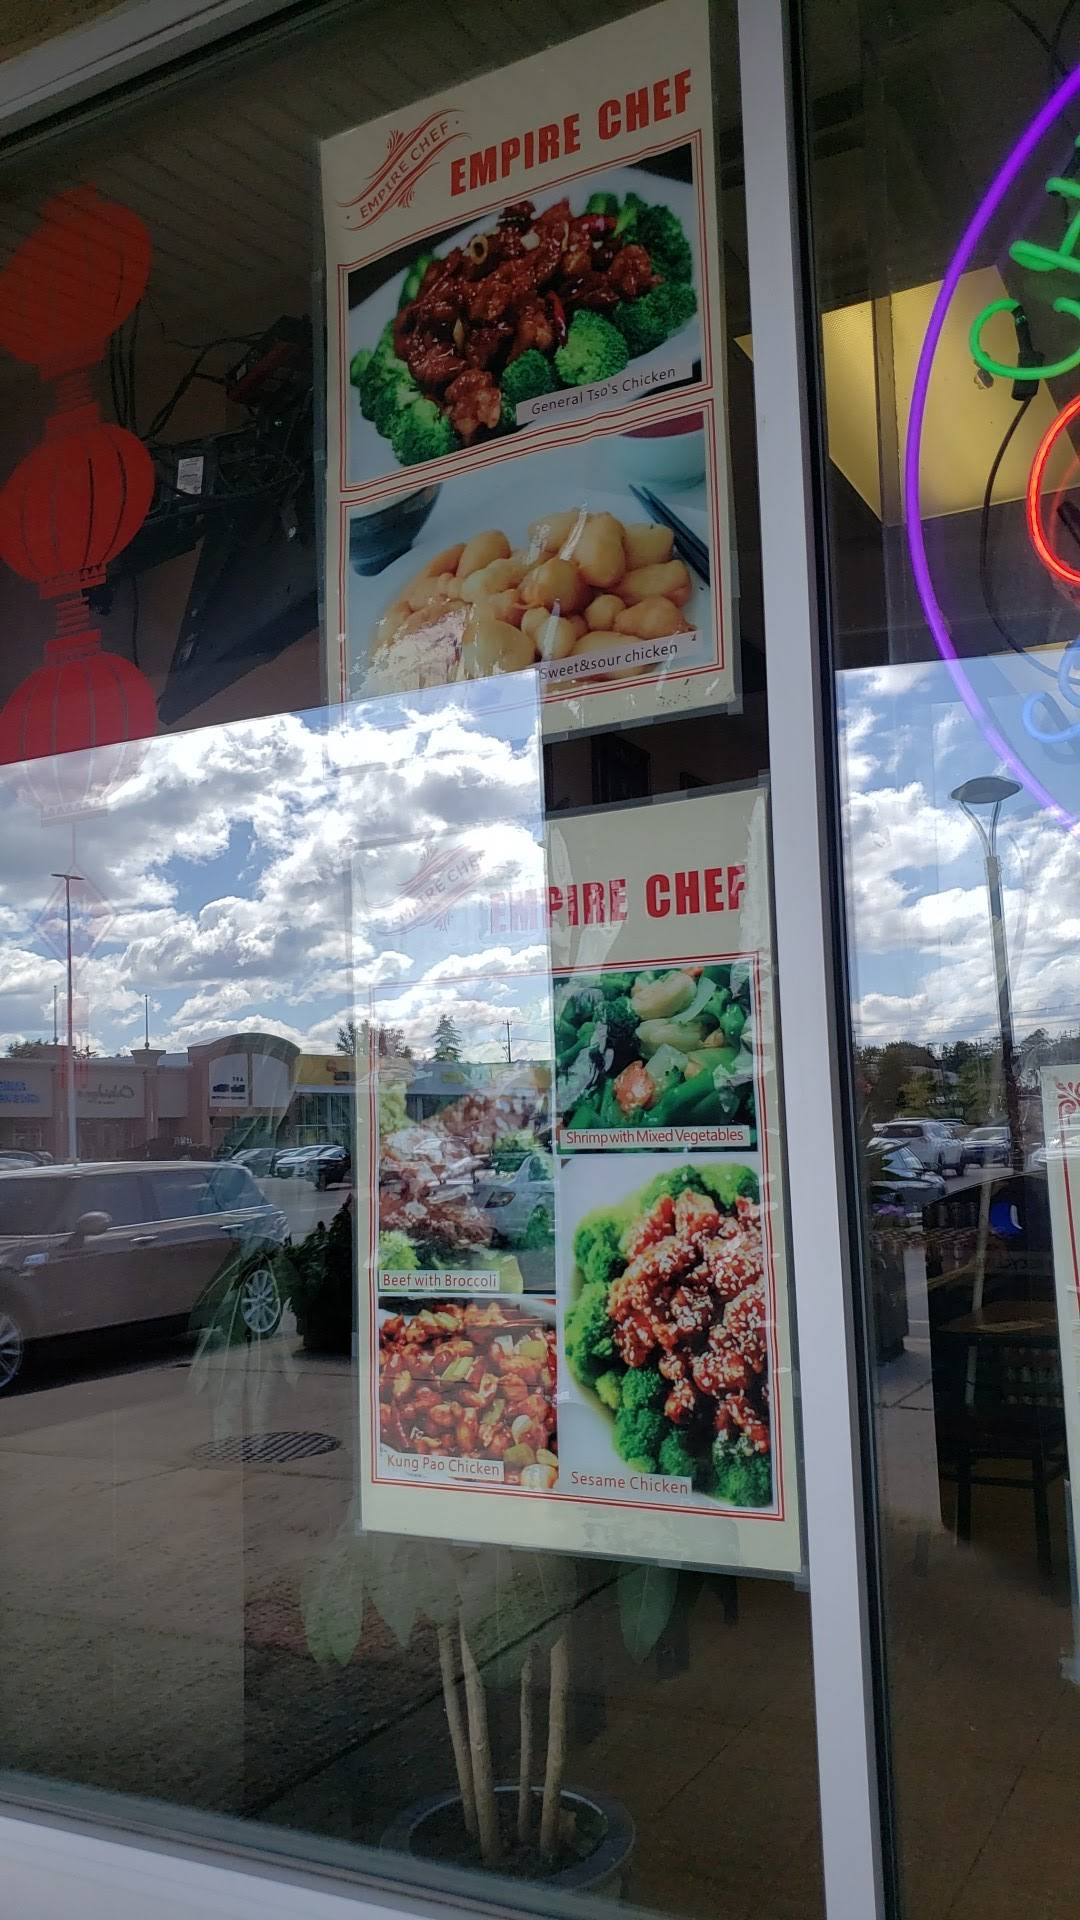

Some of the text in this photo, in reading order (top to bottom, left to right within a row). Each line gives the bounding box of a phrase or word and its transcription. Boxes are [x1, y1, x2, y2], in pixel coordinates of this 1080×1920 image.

[451, 69, 692, 196] EMPIRE CHEF
[360, 121, 449, 218] EMPIRE CHEF
[532, 367, 676, 415] General Tso's Chicken
[540, 643, 678, 680] Sweet&sour chicken
[490, 864, 746, 934] EMPIRE CHEF
[566, 1127, 744, 1146] Shrimp with Mixed Vegetables
[383, 1273, 497, 1287] Beef with Broccoli
[387, 1455, 500, 1476] Kung Pao Chicken
[571, 1471, 688, 1494] Sesame Chicken
